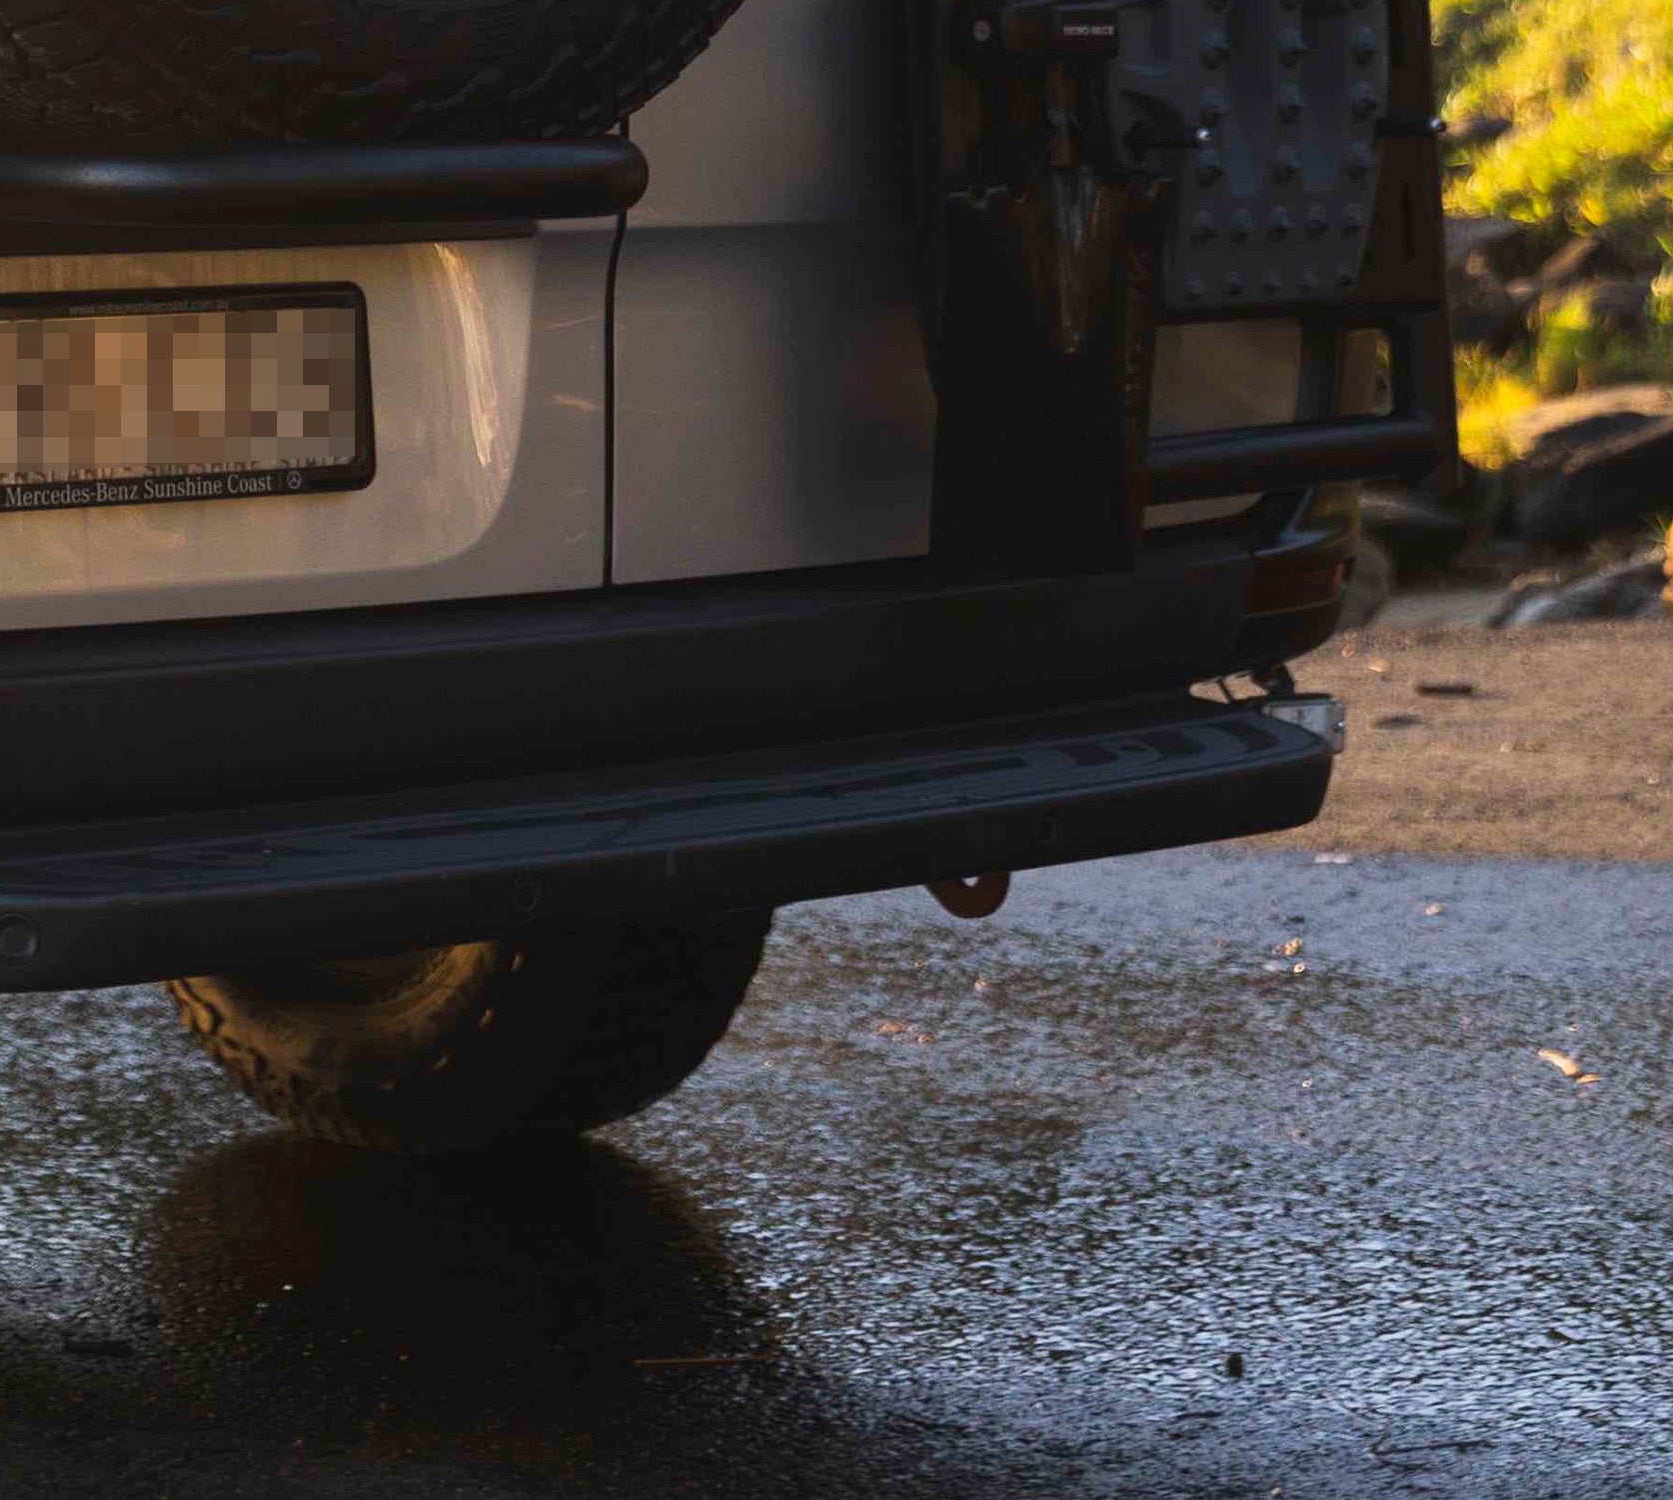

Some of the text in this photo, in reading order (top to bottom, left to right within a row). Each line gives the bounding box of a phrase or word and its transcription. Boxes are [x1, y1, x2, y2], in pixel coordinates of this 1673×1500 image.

[6, 482, 139, 507] Mercedes-Benz
[143, 476, 225, 499] Sunshine
[227, 474, 273, 494] Coast
